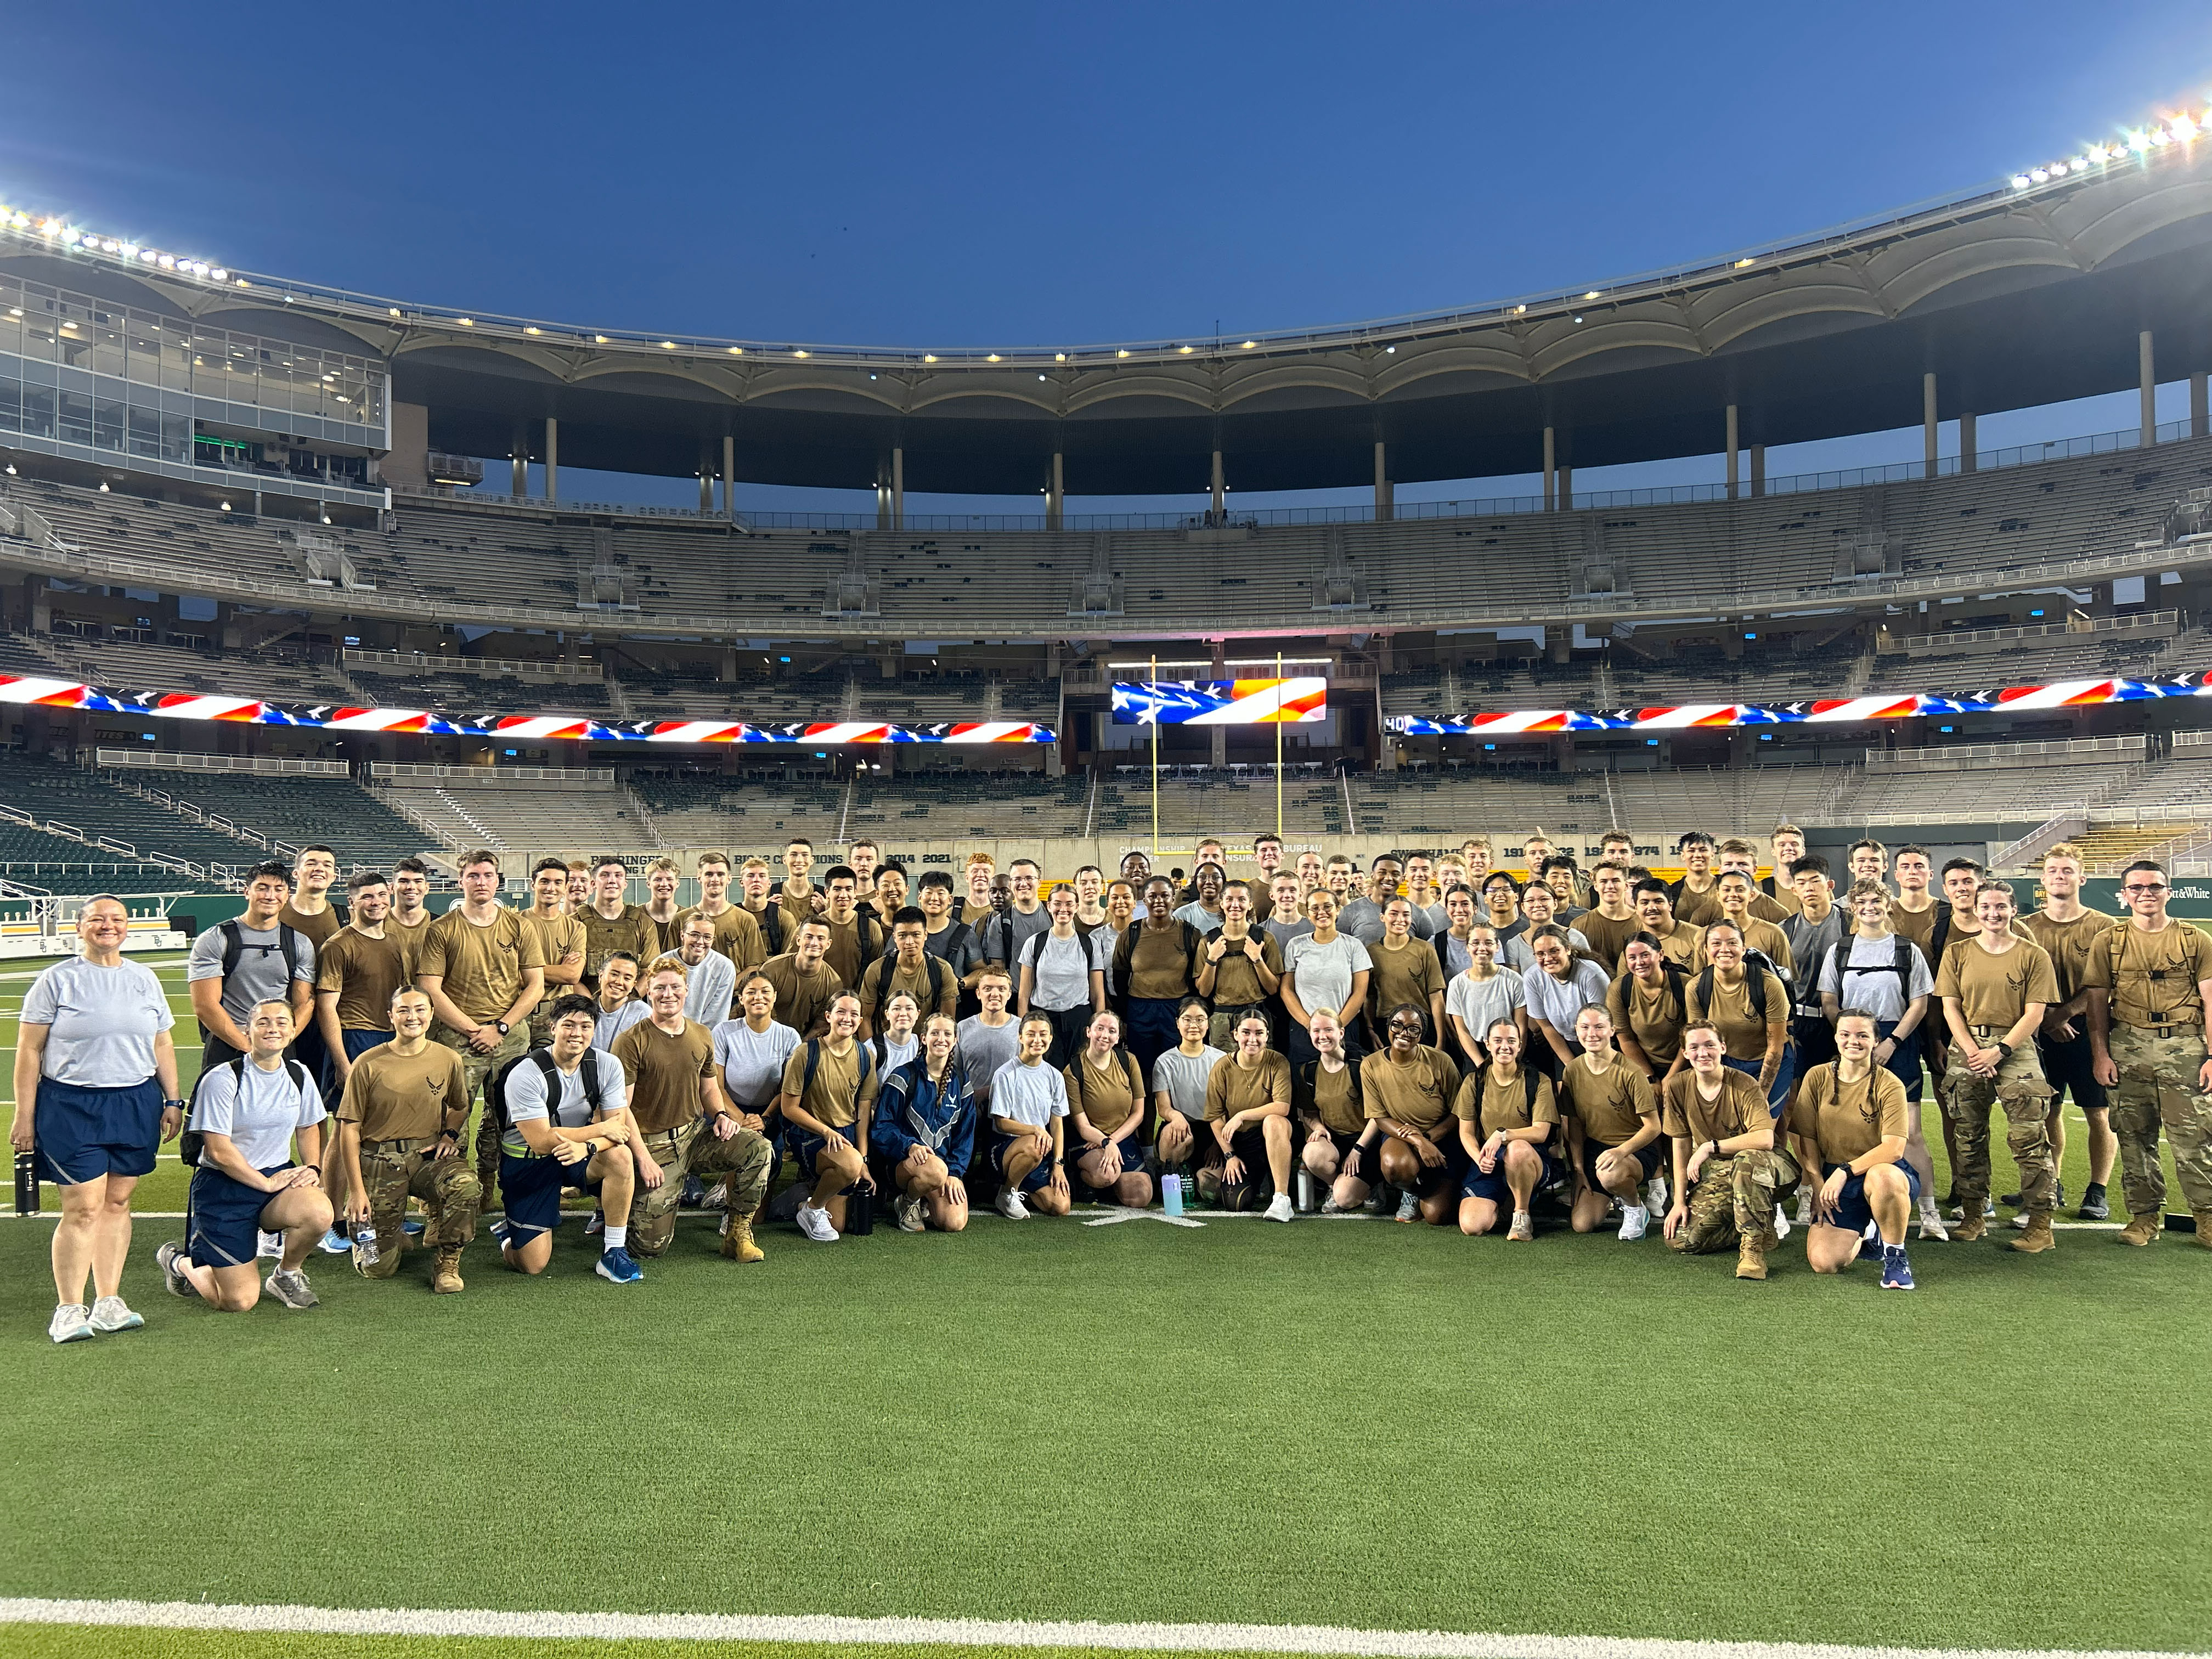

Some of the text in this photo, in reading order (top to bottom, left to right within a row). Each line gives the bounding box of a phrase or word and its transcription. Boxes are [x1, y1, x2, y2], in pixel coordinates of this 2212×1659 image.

[1386, 717, 1404, 730] 40
[1119, 845, 1186, 854] CHAMPINSHIP
[1504, 848, 1524, 857] 191
[1585, 847, 1604, 856] 19
[1634, 846, 1659, 855] 974
[774, 855, 843, 864] CIONS
[886, 854, 915, 863] 2014
[923, 854, 952, 862] 2021
